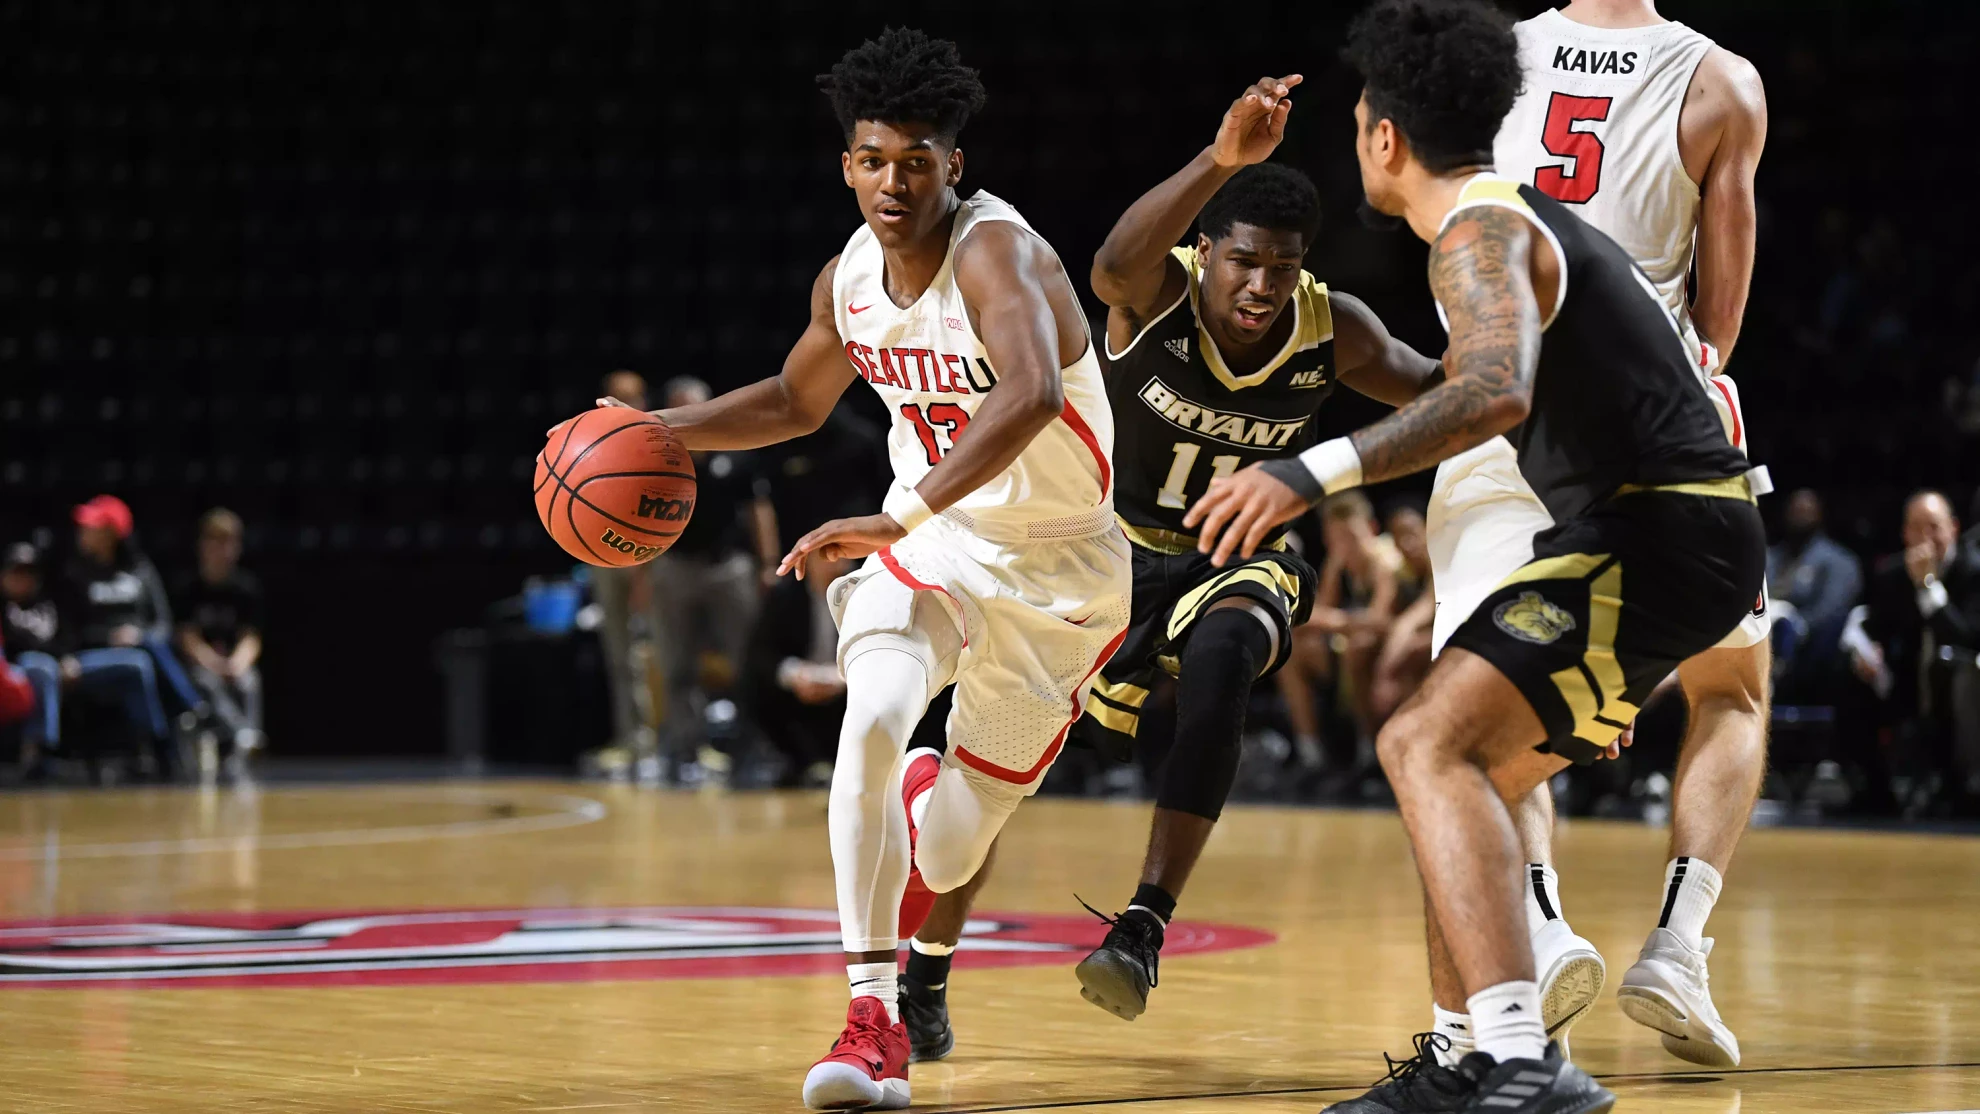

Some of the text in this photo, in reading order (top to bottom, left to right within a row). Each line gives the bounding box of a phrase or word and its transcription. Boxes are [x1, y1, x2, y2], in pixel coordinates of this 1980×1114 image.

[1552, 46, 1638, 75] KAVAS
[1534, 91, 1613, 205] 5
[1164, 340, 1190, 363] adidas
[1142, 381, 1306, 447] BRYANT
[637, 494, 693, 522] NCAA
